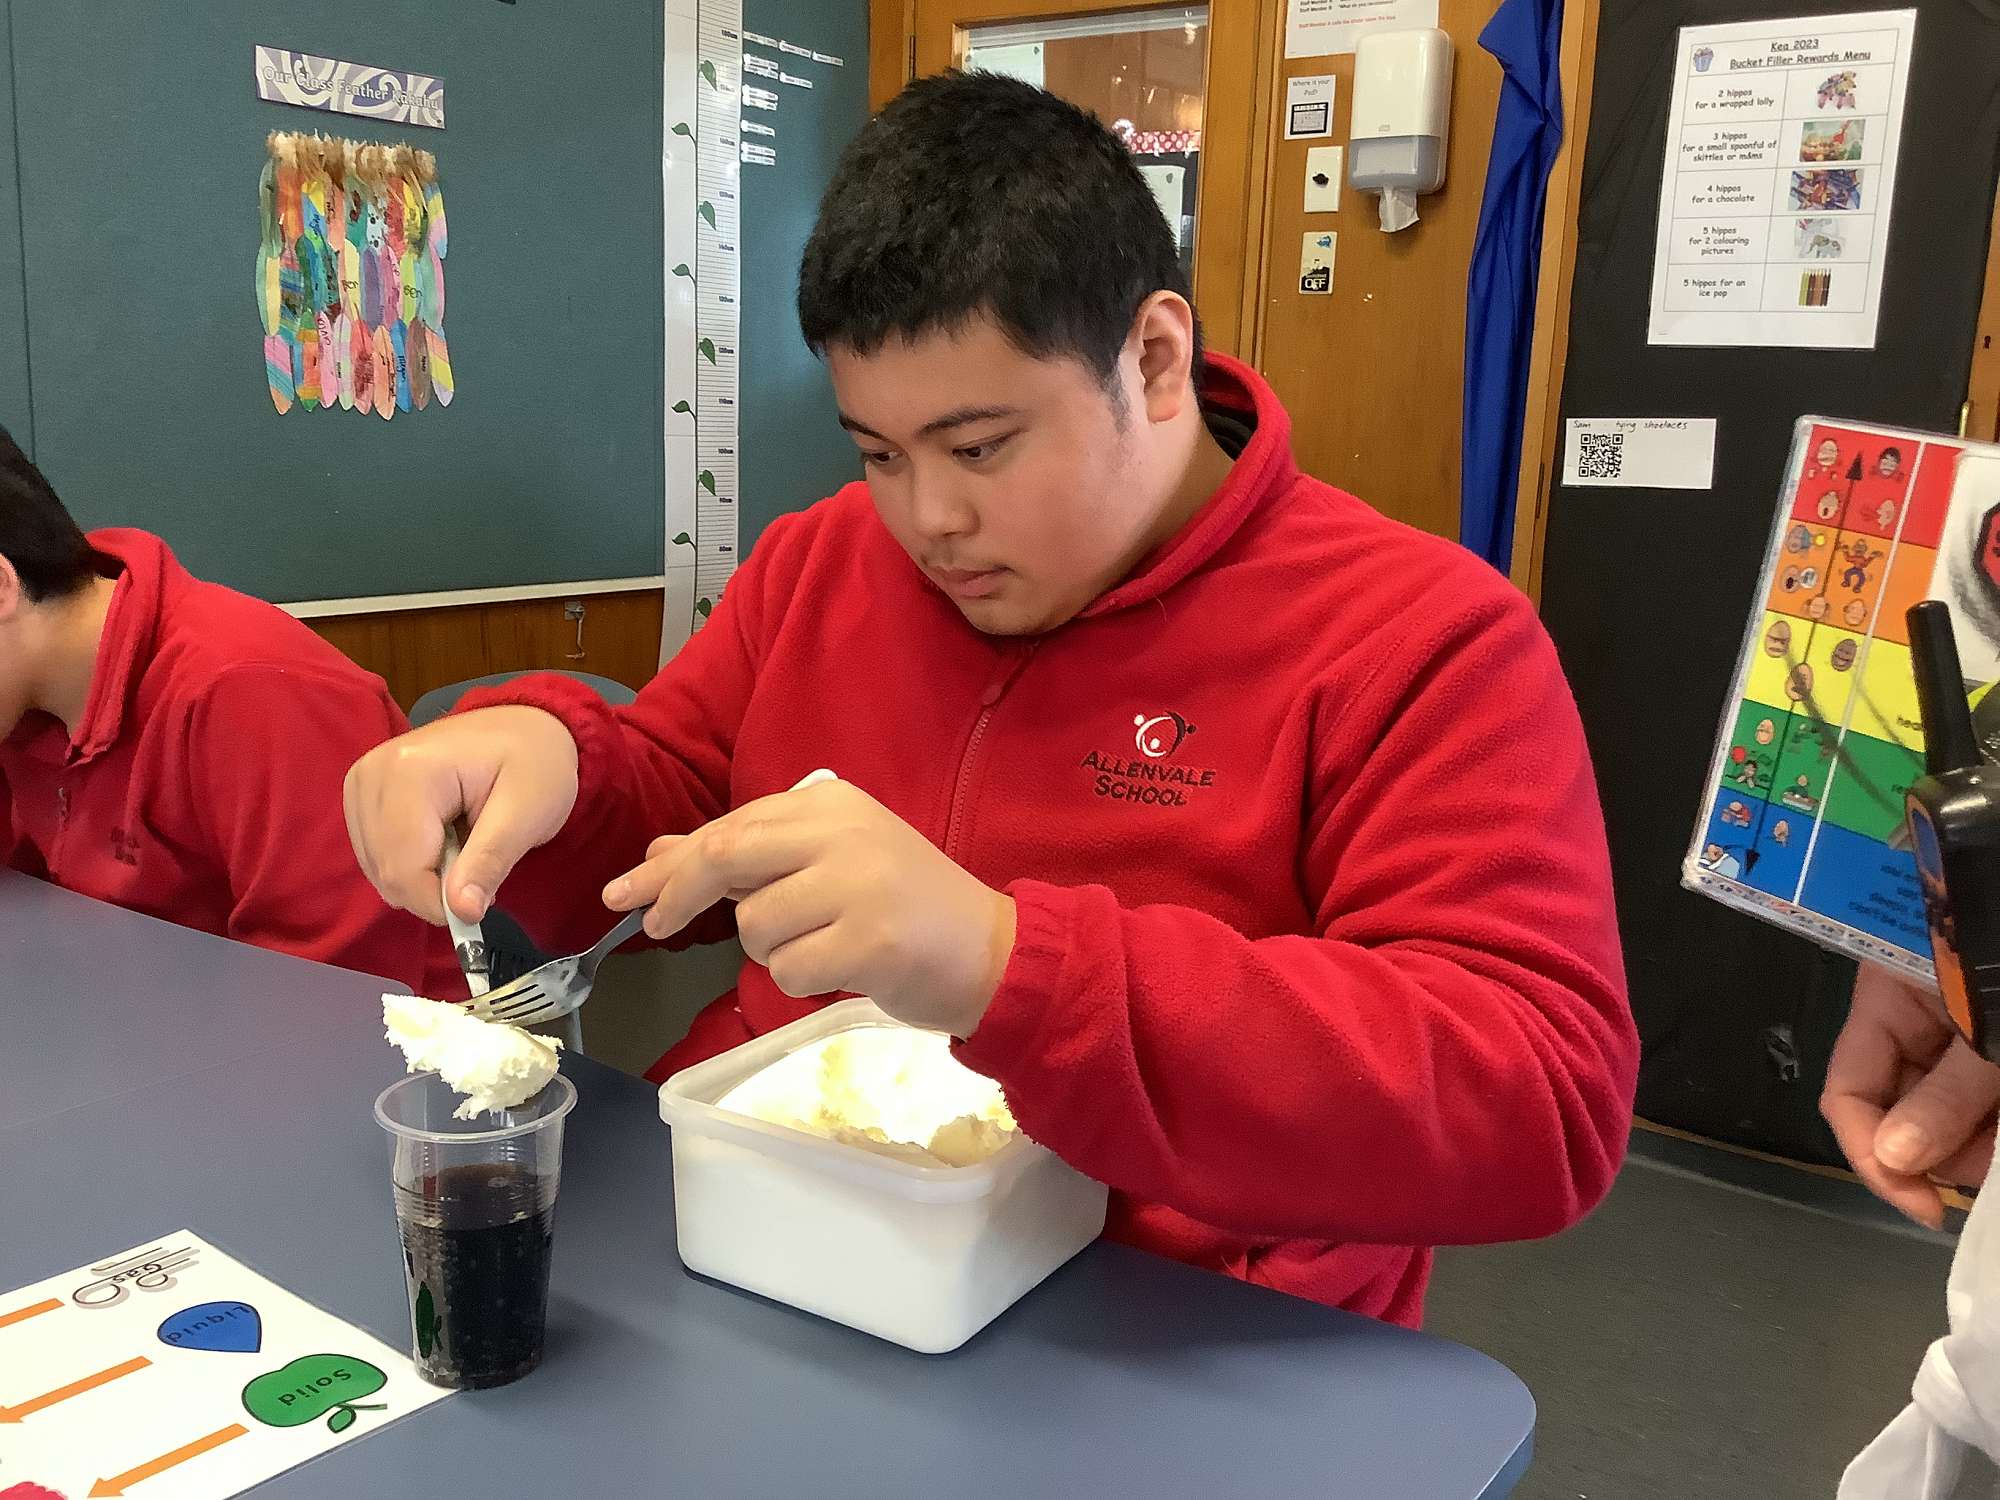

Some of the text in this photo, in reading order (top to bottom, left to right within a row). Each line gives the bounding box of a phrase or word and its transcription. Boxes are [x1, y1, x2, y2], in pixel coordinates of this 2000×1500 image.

[1770, 39, 1819, 51] Kea 2023
[1730, 51, 1871, 70] Bucket Filler Rewards Menu
[262, 66, 292, 83] Our
[296, 72, 333, 91] Class
[338, 80, 388, 100] Feather
[1717, 88, 1753, 99] 2 hippos
[1694, 101, 1708, 110] for
[1719, 99, 1754, 109] wrapped
[1757, 97, 1774, 107] lolly
[1713, 132, 1748, 142] 3 hippos
[1682, 143, 1695, 152] for
[1706, 142, 1728, 151] small
[1730, 140, 1765, 151] spoonful
[1767, 140, 1777, 149] of
[1693, 153, 1724, 161] skittles
[1715, 184, 1742, 194] hippos
[1691, 195, 1705, 204] for
[1716, 194, 1755, 203] chocolate
[1711, 226, 1737, 236] hippos
[1689, 236, 1750, 246] for 2 colouring
[1701, 248, 1734, 256] pictures
[1304, 278, 1326, 289] OFF
[1683, 279, 1689, 287] 5
[1692, 279, 1717, 288] hippos
[1720, 278, 1733, 287] for
[1713, 290, 1728, 298] pop
[1615, 421, 1637, 433] tying
[1643, 420, 1688, 430] shoelaces
[1080, 750, 1217, 787] ALLENVALE
[1094, 774, 1188, 807] SCHOOL
[112, 1262, 162, 1284] Gas
[165, 1304, 254, 1344] Liquid
[277, 1367, 353, 1407] Solid
